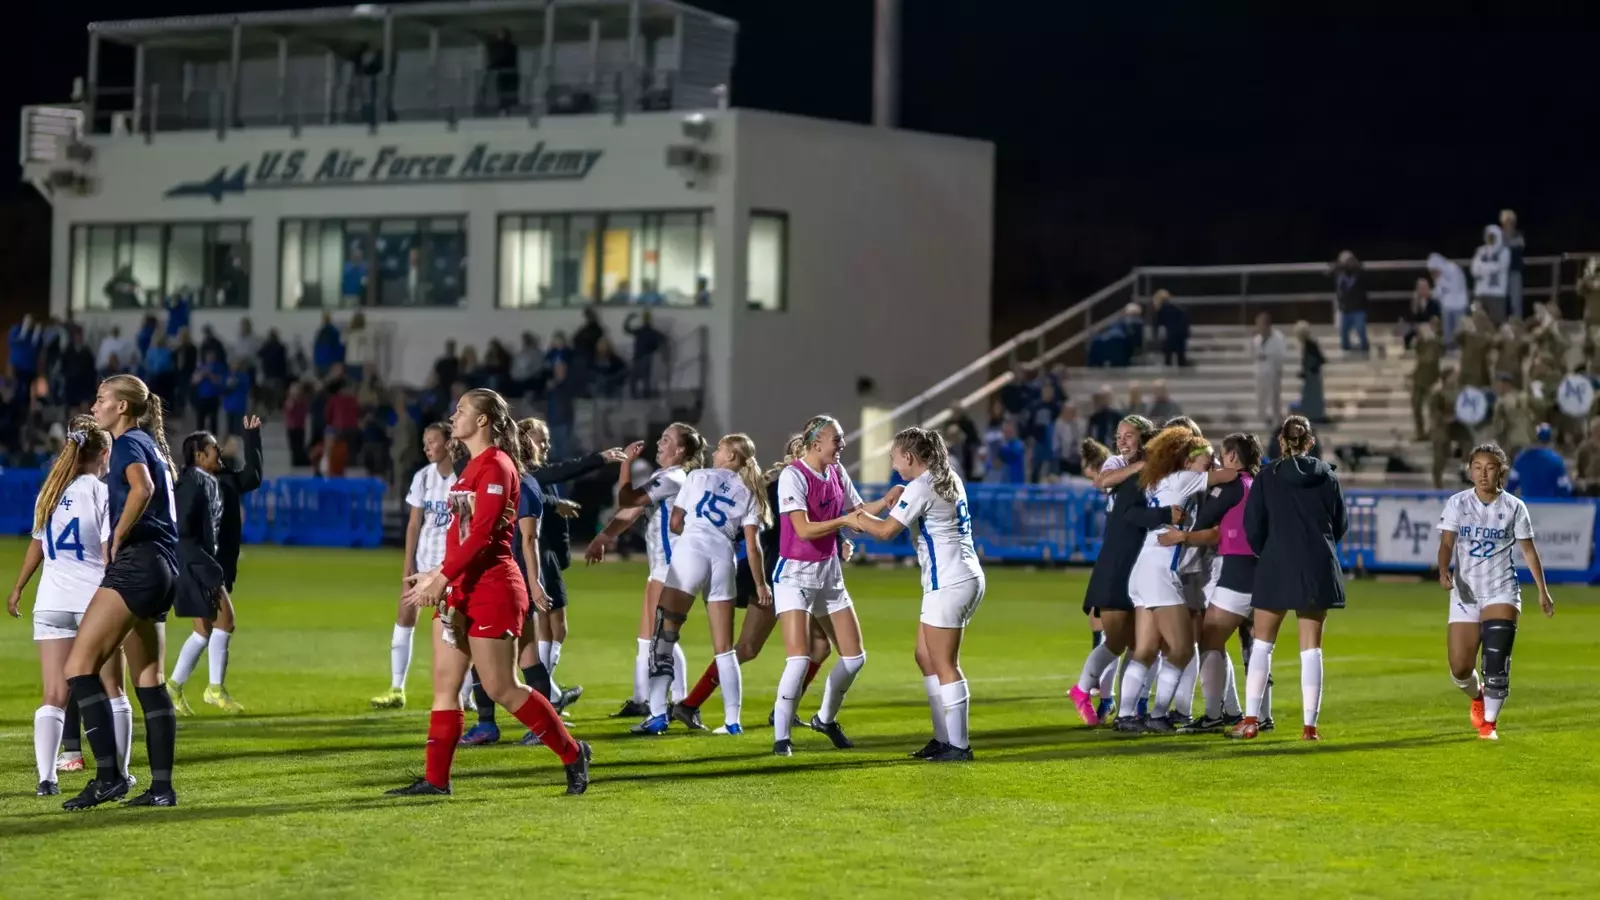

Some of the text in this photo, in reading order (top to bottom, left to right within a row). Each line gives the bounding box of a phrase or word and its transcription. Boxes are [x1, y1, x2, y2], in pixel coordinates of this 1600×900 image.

[256, 140, 604, 182] U.S. Air Force Academy
[720, 482, 730, 494] AF
[60, 495, 73, 511] AF
[695, 490, 736, 527] 15
[46, 516, 85, 561] 14
[1392, 507, 1432, 555] AF
[1475, 526, 1510, 540] FORCE
[1468, 540, 1496, 557] 22
